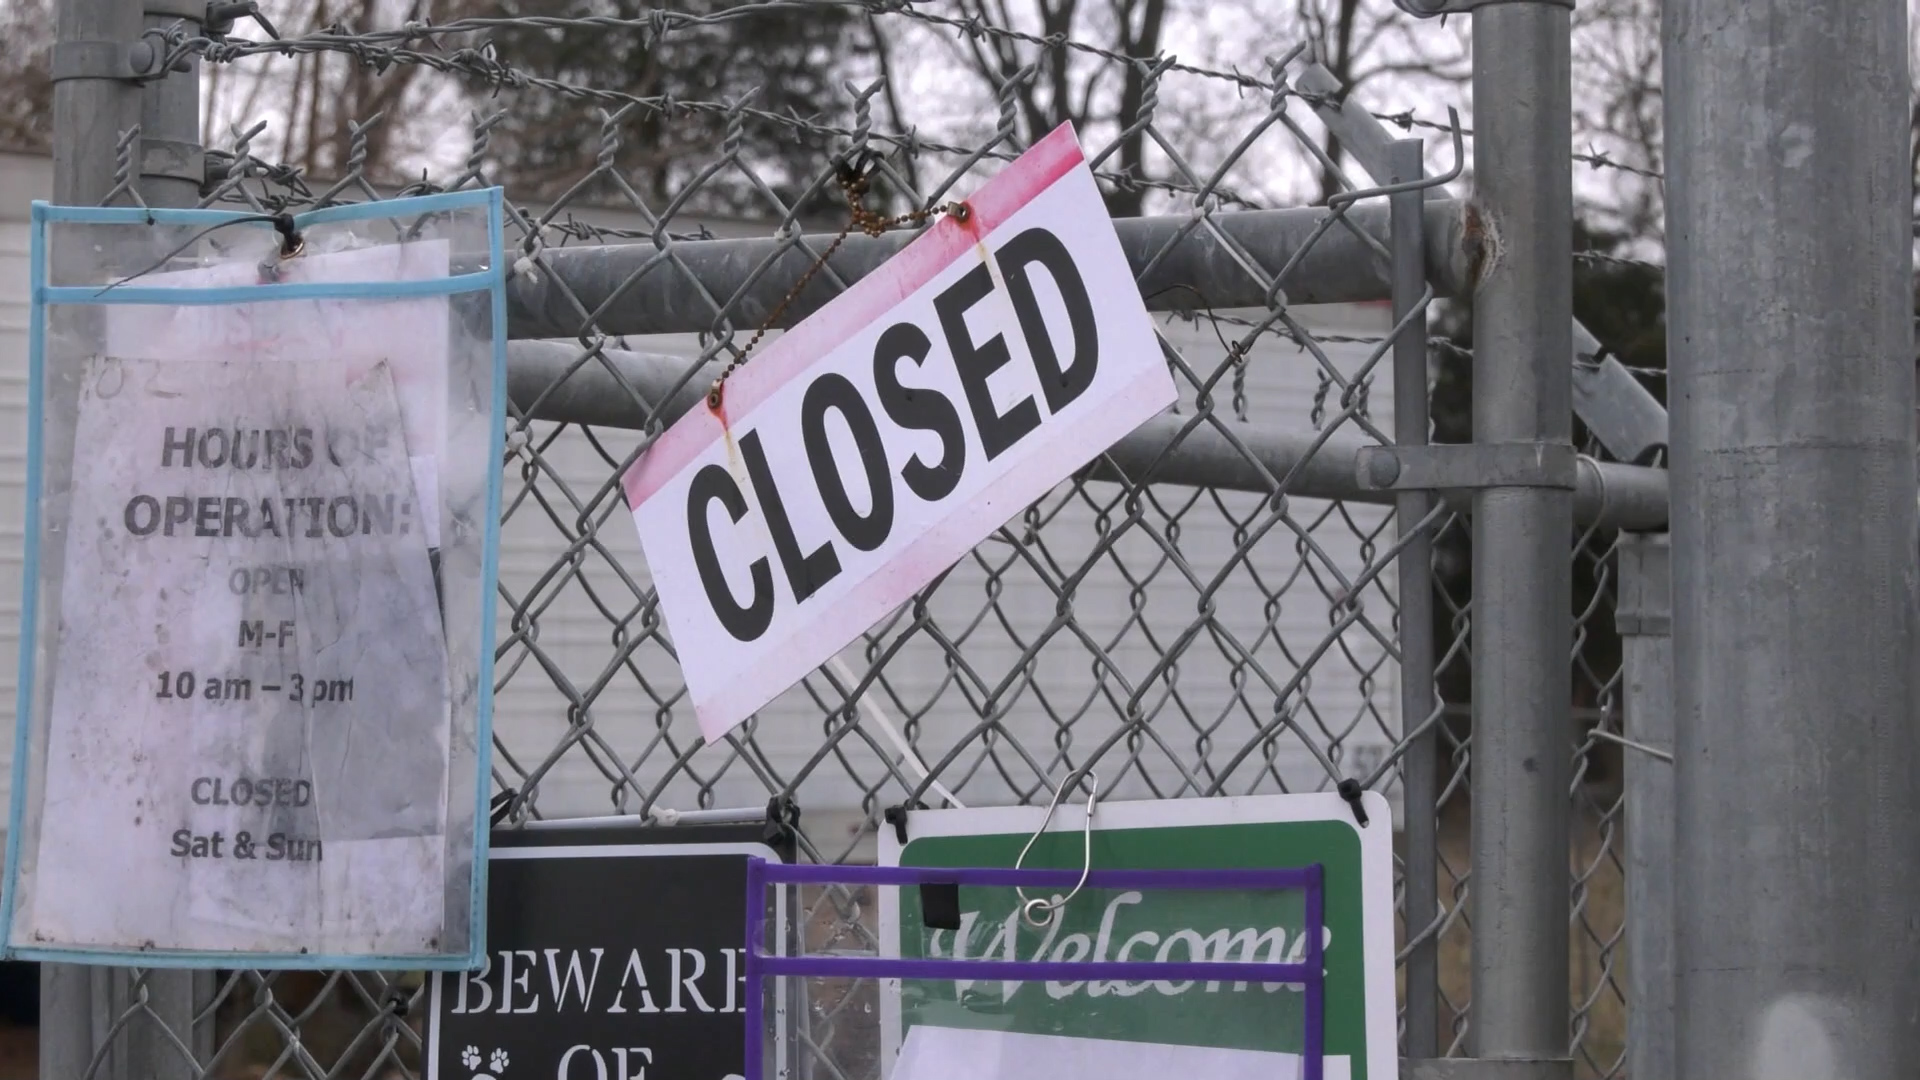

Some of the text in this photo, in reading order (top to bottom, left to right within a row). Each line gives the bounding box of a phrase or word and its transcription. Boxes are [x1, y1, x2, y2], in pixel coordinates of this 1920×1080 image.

[161, 426, 314, 470] HOURS
[687, 227, 1099, 642] CLOSED
[124, 494, 411, 538] OPERATION:
[229, 567, 305, 596] OPEN
[238, 620, 296, 648] M-F
[156, 670, 195, 699] 10
[204, 677, 251, 700] am
[289, 673, 304, 702] 3
[311, 676, 354, 709] pm
[191, 777, 311, 807] CLOSED
[171, 829, 323, 862] Sat & Sun
[929, 891, 1332, 1004] Welcome
[451, 948, 746, 1014] BEWARE
